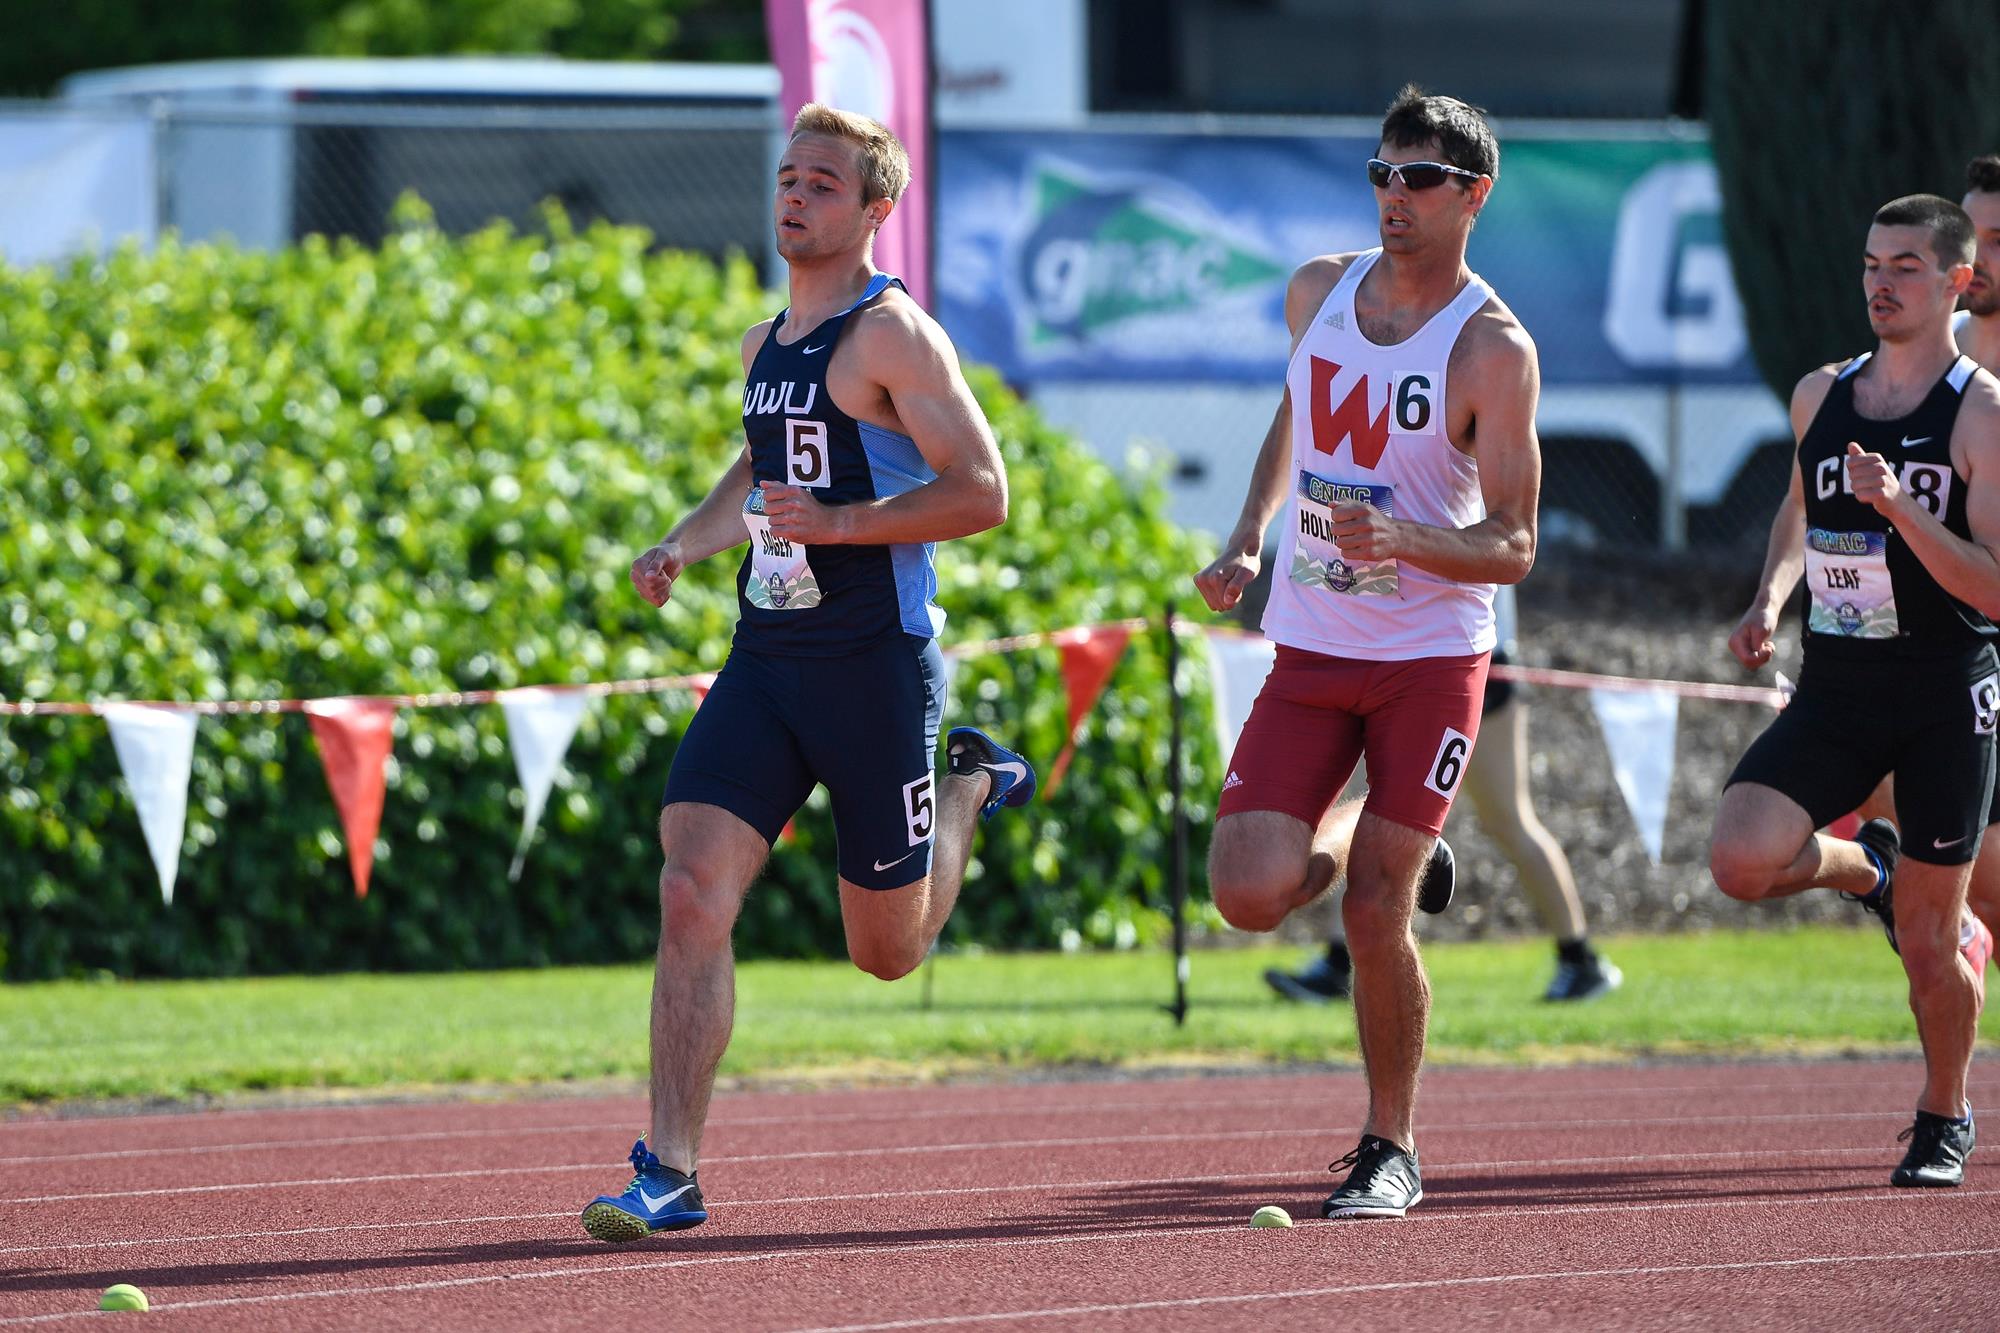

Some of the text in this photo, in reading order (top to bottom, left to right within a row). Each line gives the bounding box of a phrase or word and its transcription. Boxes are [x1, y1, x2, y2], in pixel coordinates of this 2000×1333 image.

[1032, 238, 1229, 324] gnac
[743, 382, 818, 417] WWU
[1310, 354, 1393, 471] W
[1395, 374, 1431, 431] 6
[792, 424, 822, 483] 5
[1909, 467, 1942, 517] 8
[760, 529, 793, 558] SAGER
[1823, 566, 1860, 590] LEAF
[1435, 737, 1467, 792] 6
[910, 779, 933, 838] 5
